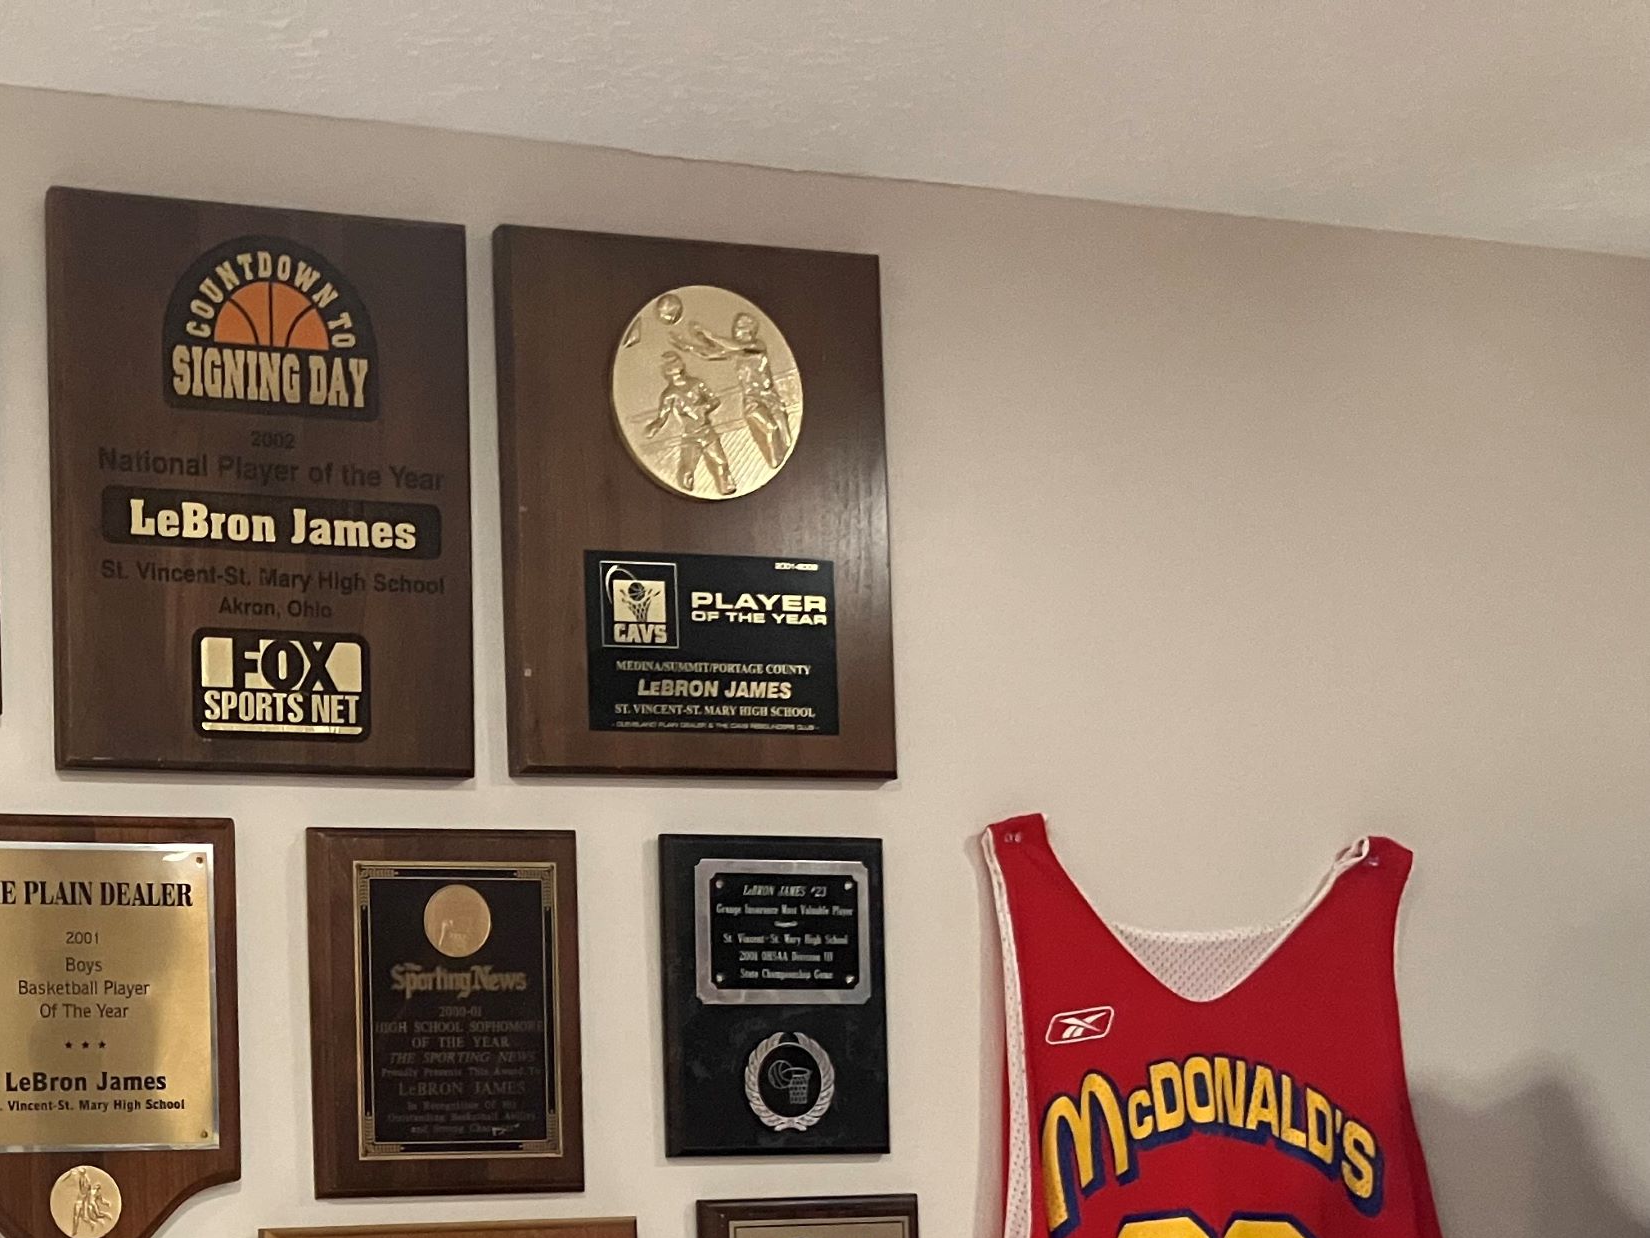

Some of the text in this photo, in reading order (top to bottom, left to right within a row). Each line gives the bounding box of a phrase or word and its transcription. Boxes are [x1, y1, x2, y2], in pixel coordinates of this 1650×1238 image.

[185, 250, 355, 349] COUNTDOWN TO
[171, 345, 369, 408] SIGNING DAY
[98, 447, 444, 491] National Player of the Year
[129, 499, 417, 550] LeBron James
[101, 559, 445, 597] St. Vincent-St. Mary High School
[218, 597, 333, 621] Akron, Ohio
[691, 591, 827, 613] PLAYER
[691, 611, 827, 625] OF THE YEAR
[614, 623, 668, 643] CAVS
[232, 638, 340, 692] FOX
[766, 665, 811, 675] COUNTY
[638, 679, 792, 699] LeBRON JAMES
[203, 690, 360, 725] SPORTS NET
[704, 706, 737, 716] MARY
[739, 706, 768, 717] HIGH
[770, 707, 816, 718] SCHOOL
[24, 881, 93, 906] PLAIN
[100, 882, 193, 907] DEALER
[65, 931, 100, 945] 2001
[65, 957, 103, 975] Boys
[19, 980, 150, 998] Basketball Player
[390, 963, 527, 999] Sporting News
[40, 1004, 129, 1018] Of The Year
[414, 1021, 463, 1033] SCHOOL
[473, 1037, 510, 1048] YEAR
[5, 1071, 167, 1092] LeBron James
[8, 1100, 74, 1111] Vincent-St.
[79, 1100, 108, 1112] Mary
[114, 1099, 141, 1112] High
[146, 1098, 185, 1110] School
[1041, 1055, 1380, 1238] McDONALD'S
